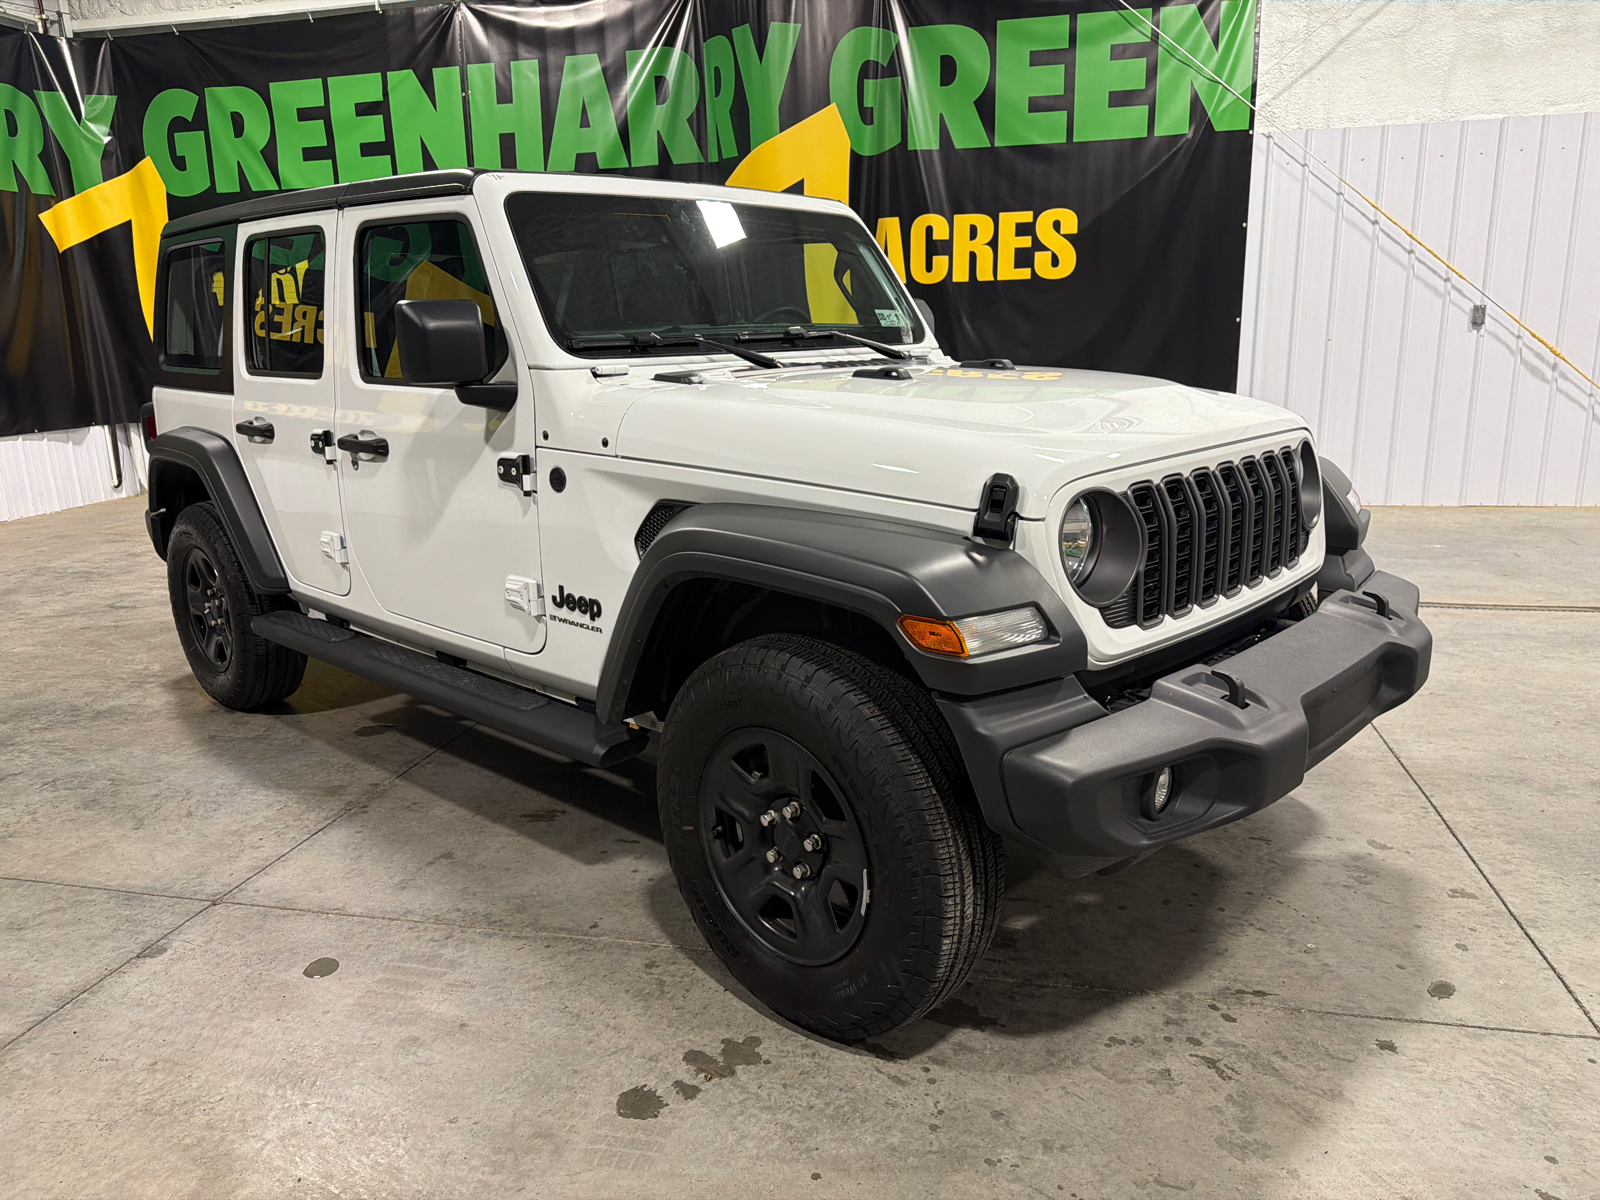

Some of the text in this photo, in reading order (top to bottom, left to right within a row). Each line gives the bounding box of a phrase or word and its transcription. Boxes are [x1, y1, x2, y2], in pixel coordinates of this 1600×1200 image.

[467, 1, 1256, 171] HARRY GREEN
[142, 66, 467, 198] GREEN
[876, 207, 1079, 286] ACRES
[551, 584, 603, 622] Jeep
[556, 615, 604, 634] WRANGLER
